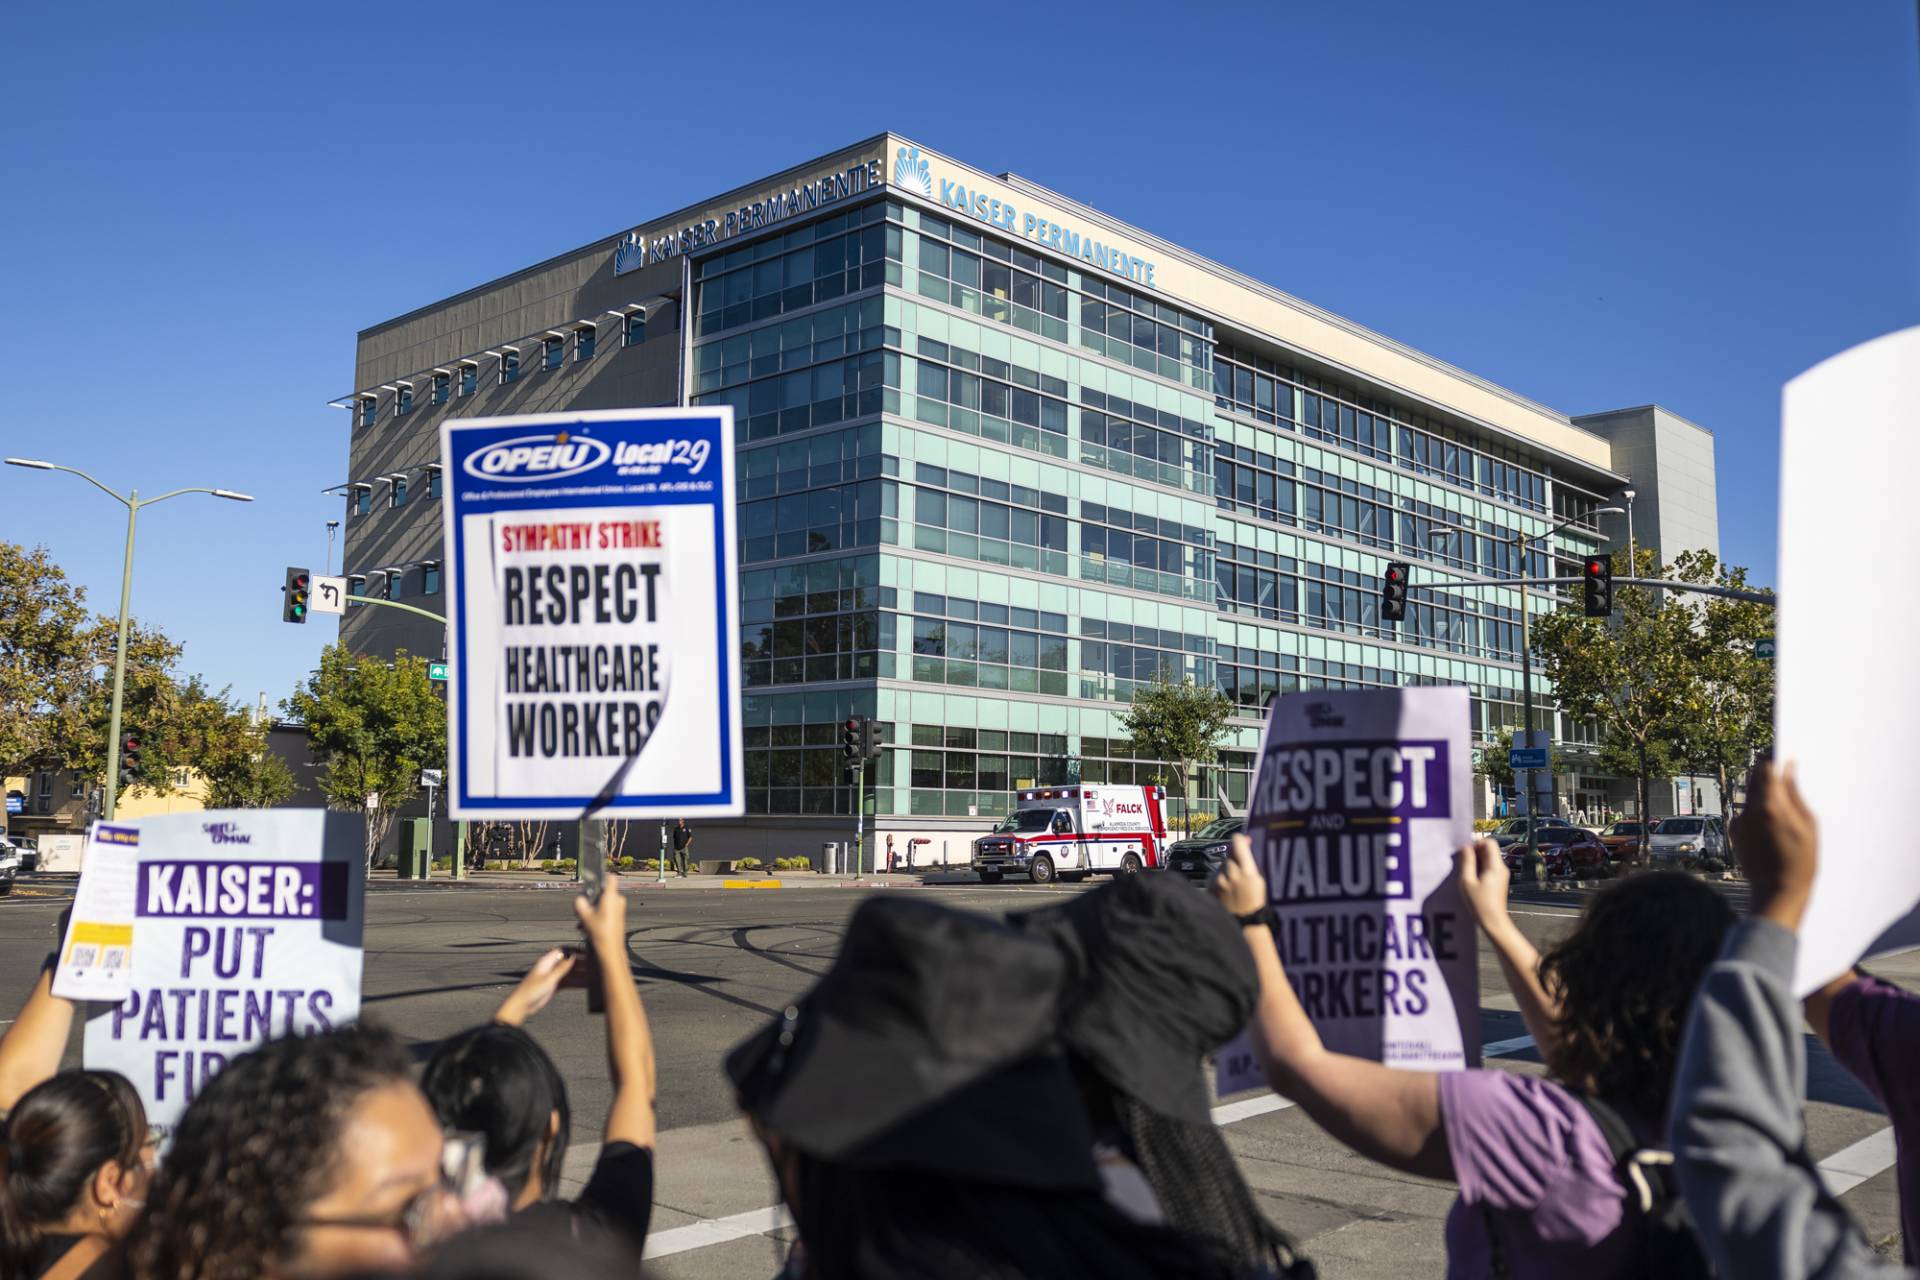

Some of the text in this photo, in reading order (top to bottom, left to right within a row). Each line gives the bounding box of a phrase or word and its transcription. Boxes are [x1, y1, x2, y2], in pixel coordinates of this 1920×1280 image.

[649, 158, 882, 266] KAISER PERMANENTE
[940, 177, 1156, 289] KAISER PERMANENTE
[480, 443, 592, 474] OPEIU
[672, 439, 711, 475] 29
[502, 520, 663, 552] SYMPATHY STRIKE
[503, 562, 662, 626] RESPECT
[505, 644, 660, 694] HEALTHCARE
[507, 699, 661, 758] WORKERS
[1255, 746, 1436, 816] RESPECT
[1116, 804, 1142, 814] FALCK
[1309, 814, 1345, 830] AND
[148, 864, 314, 916] KAISER:
[1267, 833, 1404, 898] VALUE
[181, 926, 274, 979] PUT
[1279, 912, 1458, 966] ALTHCARE
[111, 989, 334, 1043] PATIENTS
[154, 1051, 227, 1101] FIR
